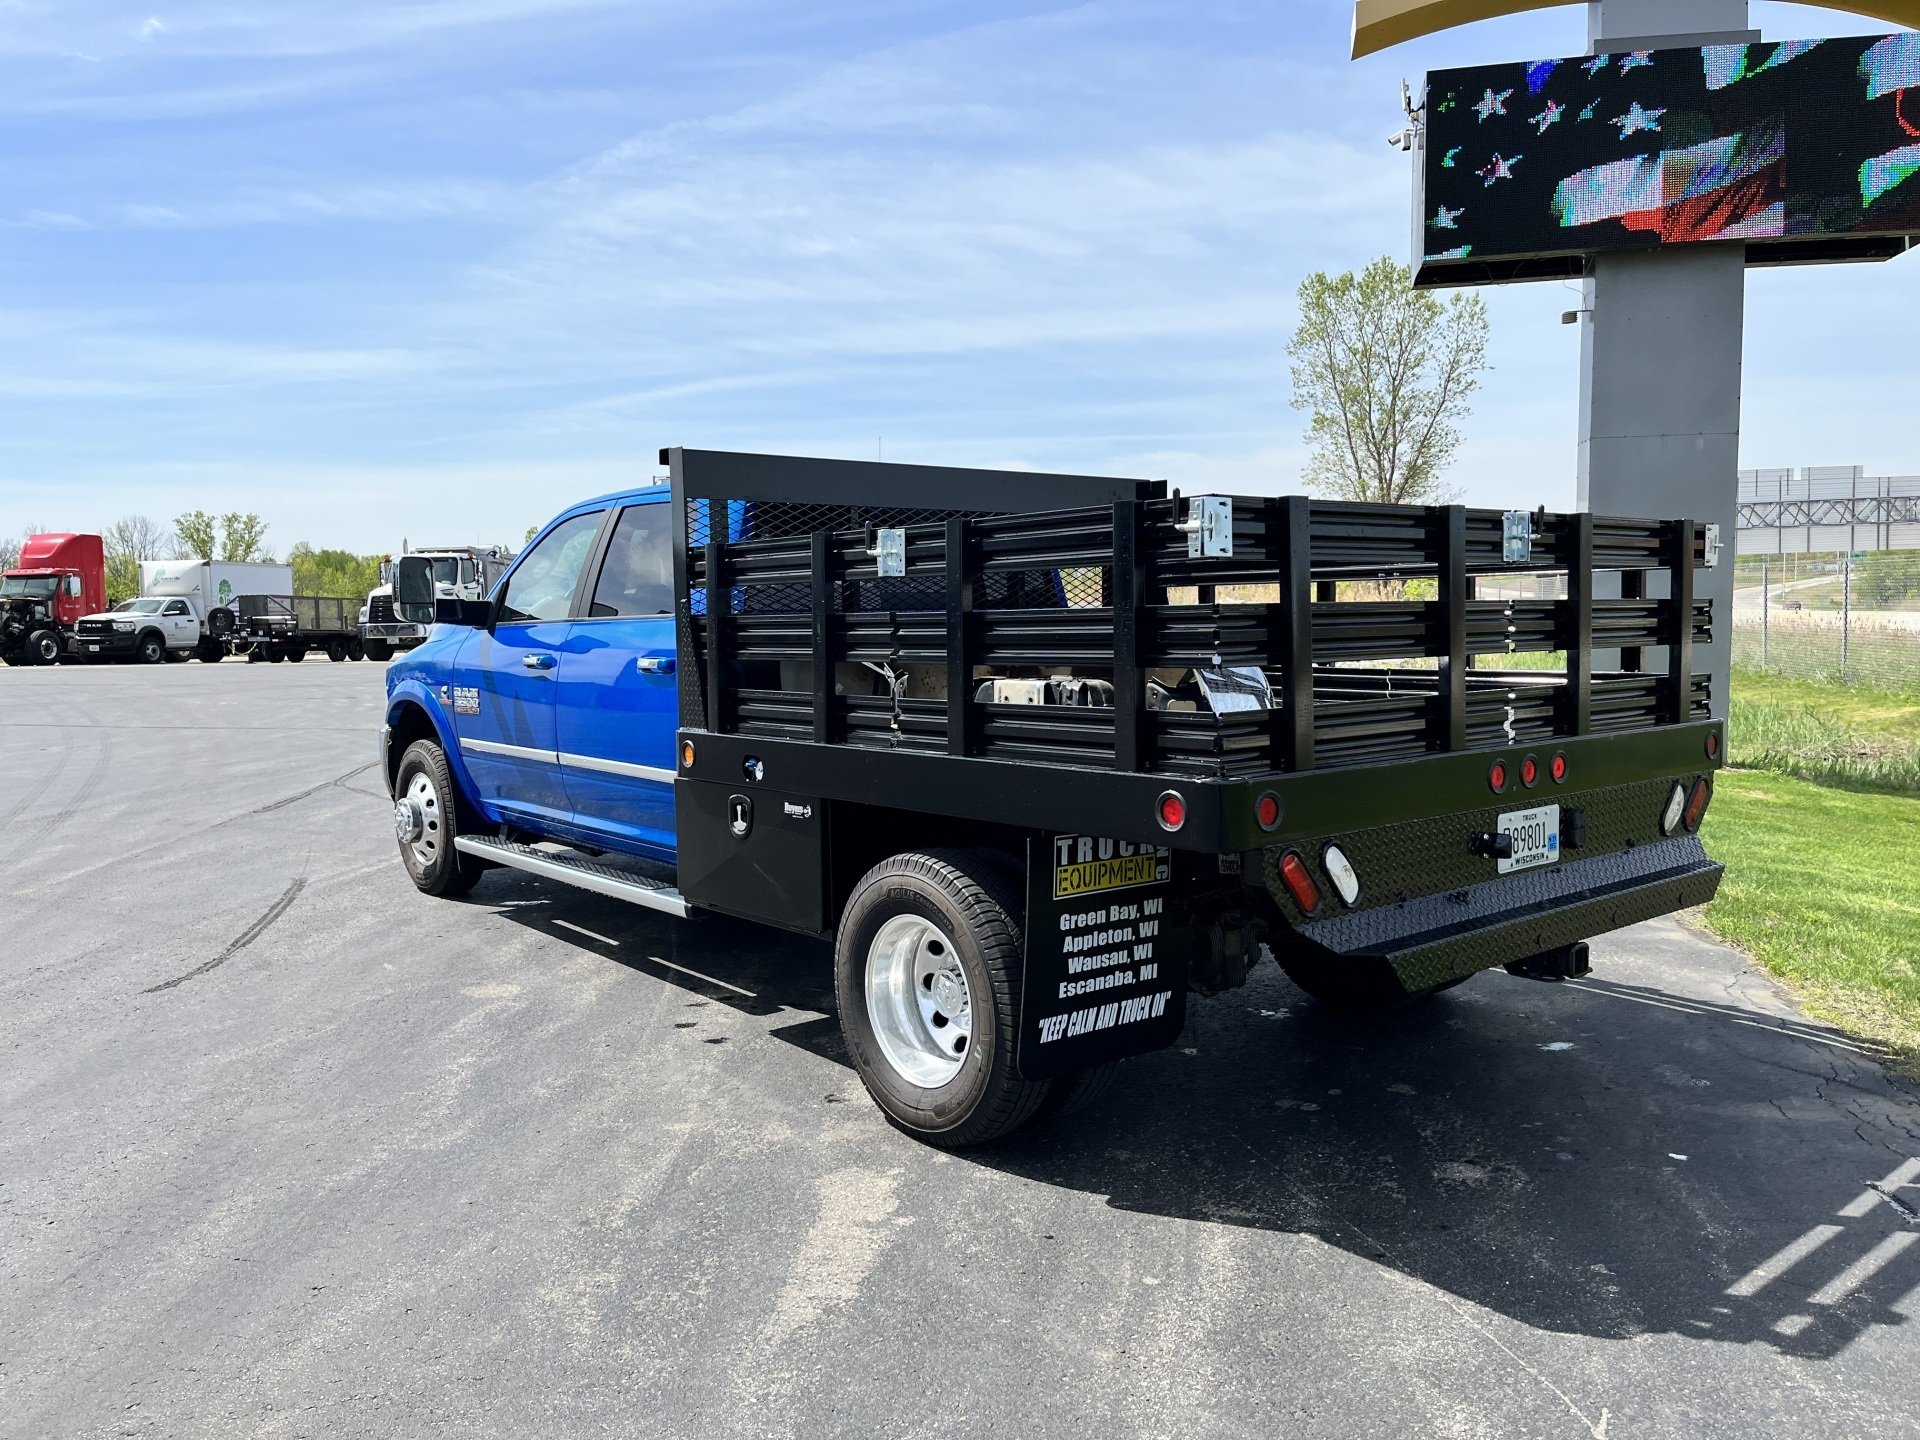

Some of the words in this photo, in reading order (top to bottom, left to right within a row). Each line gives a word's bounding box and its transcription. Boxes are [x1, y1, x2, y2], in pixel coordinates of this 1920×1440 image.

[453, 687, 479, 697] RAM
[1522, 813, 1537, 821] TRUCK
[1503, 821, 1547, 854] 89801
[1058, 856, 1155, 893] EQUIPMENT
[1515, 852, 1545, 865] WISCONSIN
[1060, 909, 1106, 931] Green
[1110, 904, 1140, 922] Bay,
[1143, 898, 1163, 915] WI
[1063, 927, 1136, 953] Appleton,
[1139, 920, 1159, 938] WI
[1068, 949, 1131, 975] Wausau,
[1133, 942, 1153, 961] WI
[1058, 970, 1136, 999] Escanaba,
[1140, 963, 1158, 981] MI
[1039, 1013, 1069, 1044] "KEEP
[1067, 1006, 1098, 1038] CALM
[1095, 1002, 1119, 1031] AND
[1118, 994, 1153, 1025] TRUCK
[1151, 990, 1172, 1018] ON"
